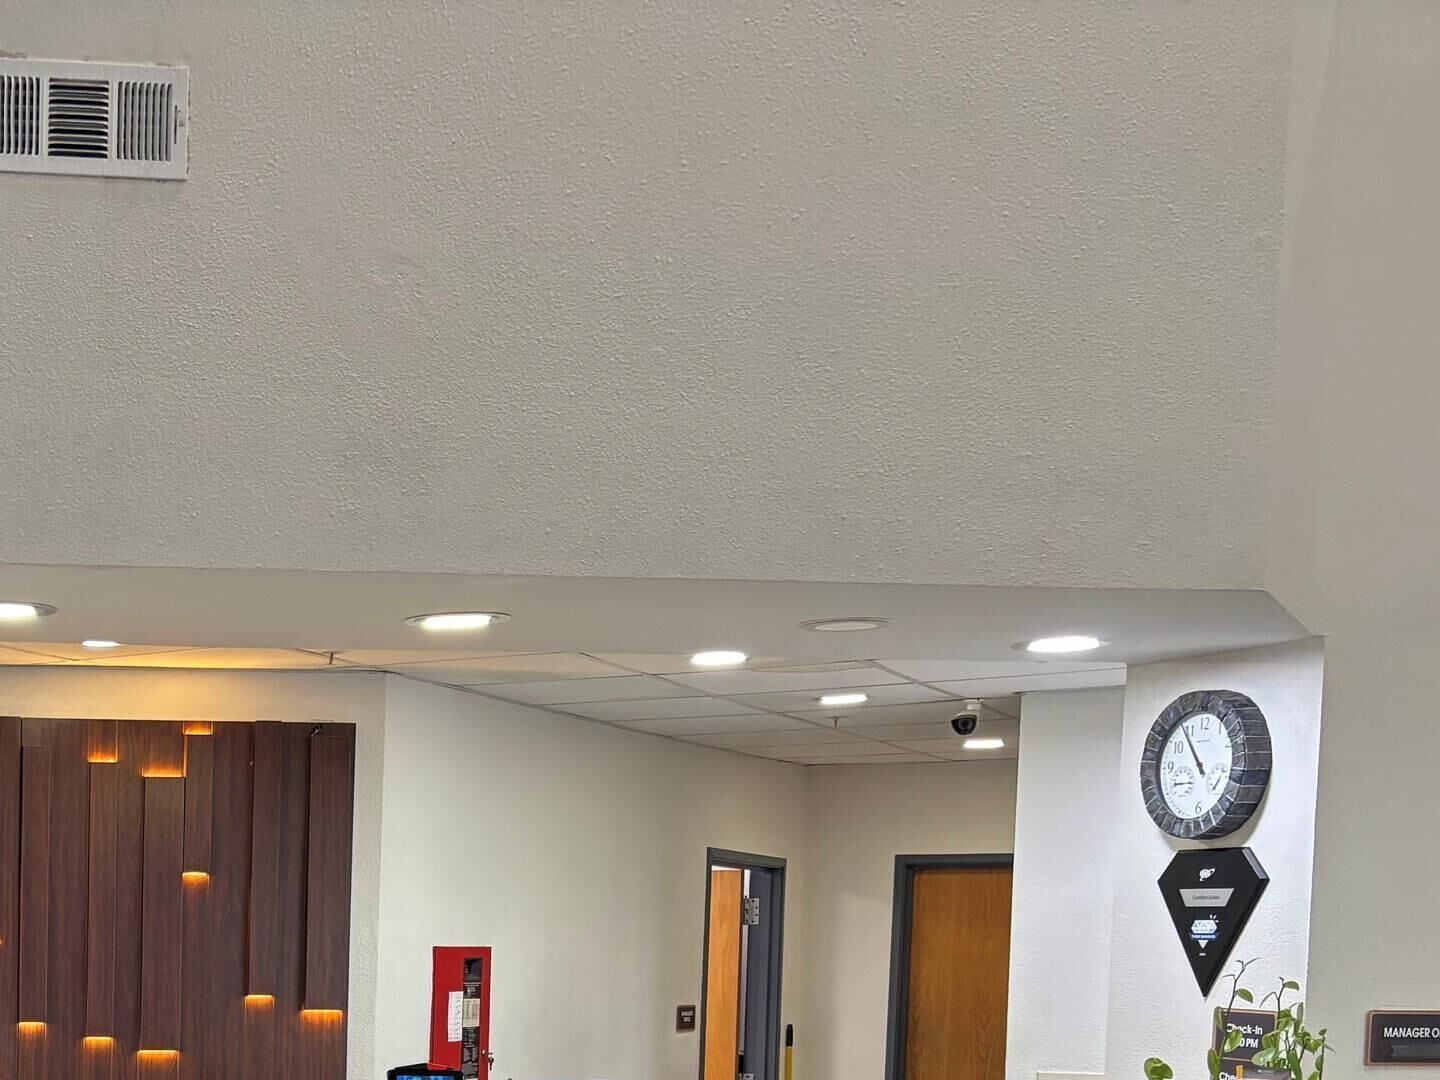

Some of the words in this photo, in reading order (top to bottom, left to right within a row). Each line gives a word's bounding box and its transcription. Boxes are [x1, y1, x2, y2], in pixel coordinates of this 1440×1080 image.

[1200, 717, 1210, 730] 12
[1186, 724, 1195, 737] 11
[1173, 740, 1184, 754] 10
[1167, 761, 1174, 774] 9
[1195, 801, 1202, 814] 6
[1383, 1027, 1430, 1038] MANAGER
[1431, 1027, 1440, 1038] O
[1246, 1038, 1259, 1048] PM
